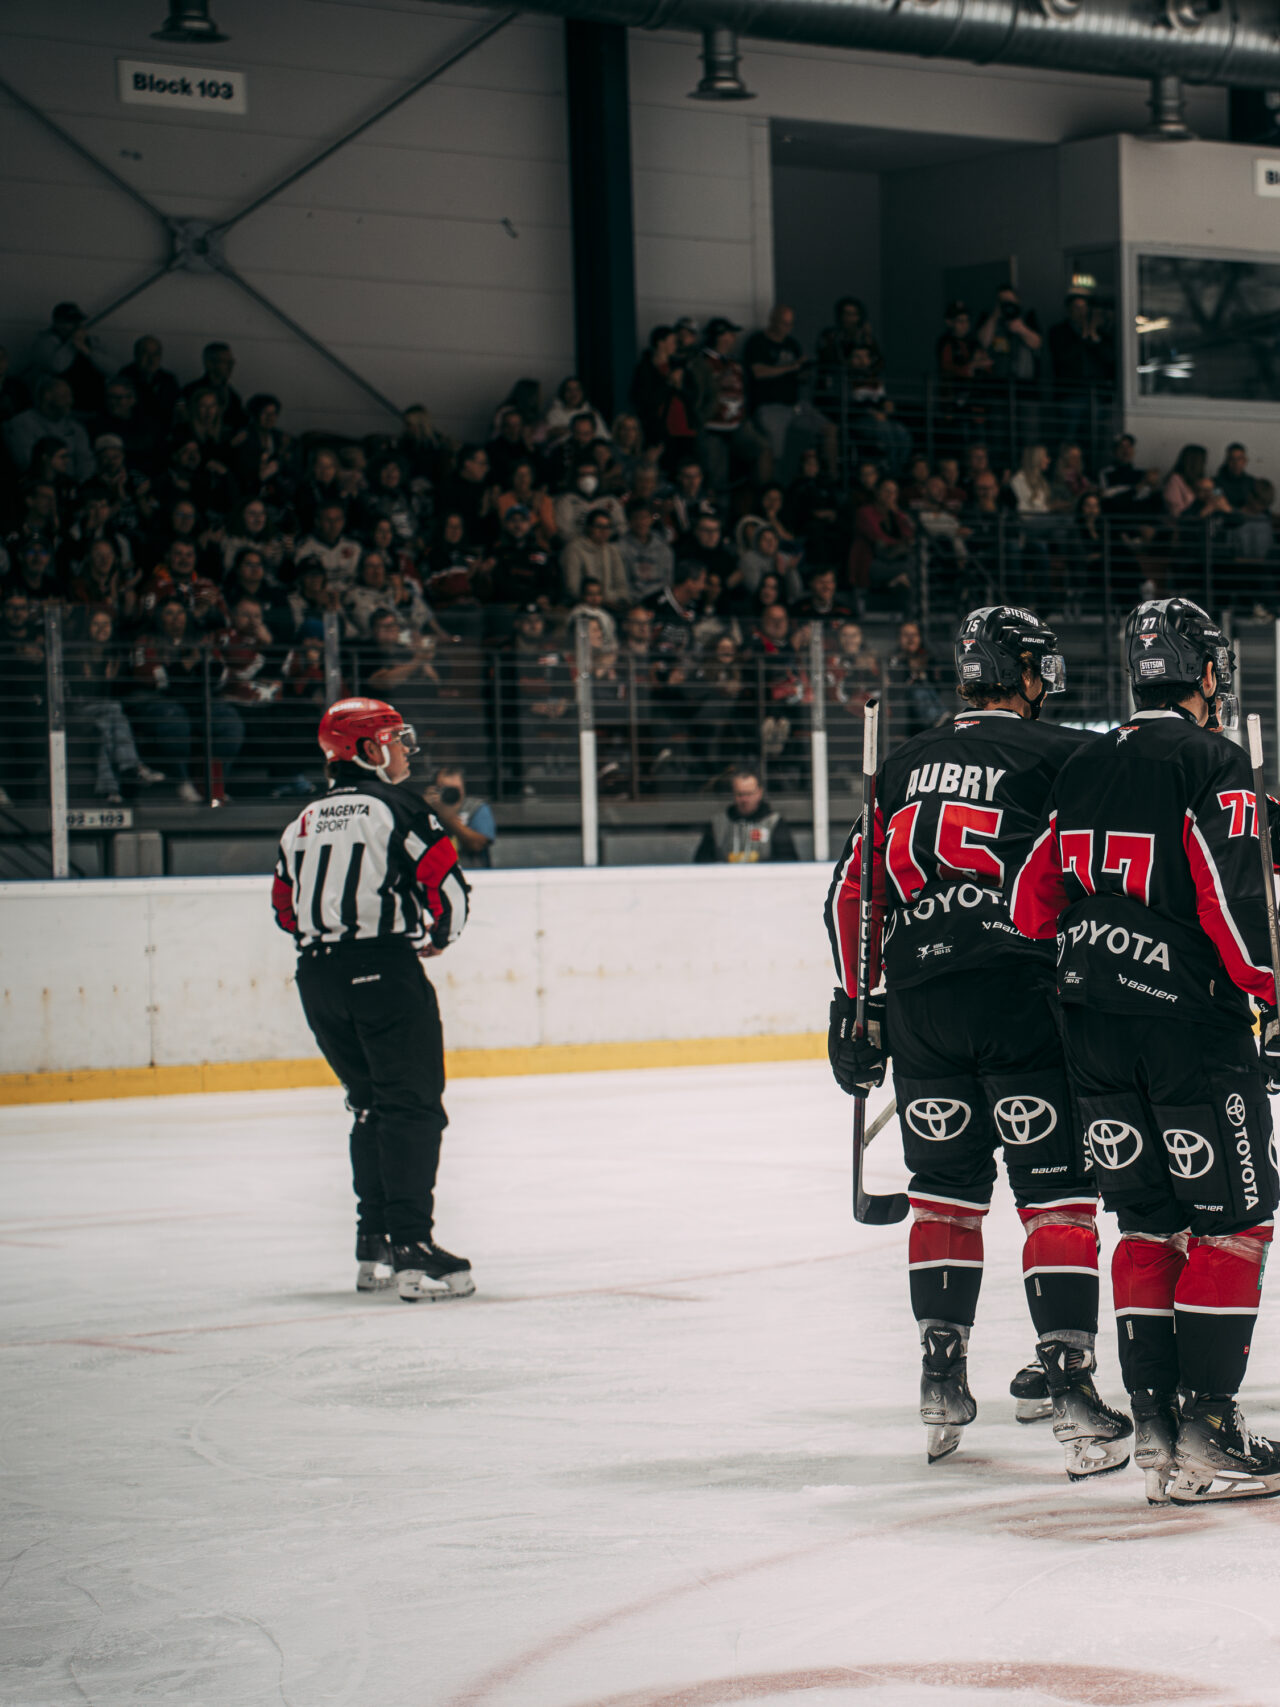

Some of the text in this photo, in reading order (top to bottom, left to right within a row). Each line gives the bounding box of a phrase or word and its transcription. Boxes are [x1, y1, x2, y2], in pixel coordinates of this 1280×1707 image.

[132, 71, 234, 100] Block 103
[966, 619, 981, 633] 15
[1003, 607, 1039, 628] STETSON
[1141, 616, 1157, 631] 77
[1022, 636, 1046, 645] BAUER
[1141, 660, 1164, 670] STETSON
[905, 761, 1006, 802] AUBRY
[318, 803, 371, 818] MAGENTA
[314, 818, 350, 834] SPORT
[886, 800, 1005, 904] 15
[1059, 828, 1156, 908] 77
[1127, 980, 1179, 1003] BAUER
[1030, 1165, 1068, 1175] BAUER
[1234, 1126, 1260, 1212] TOYOTA
